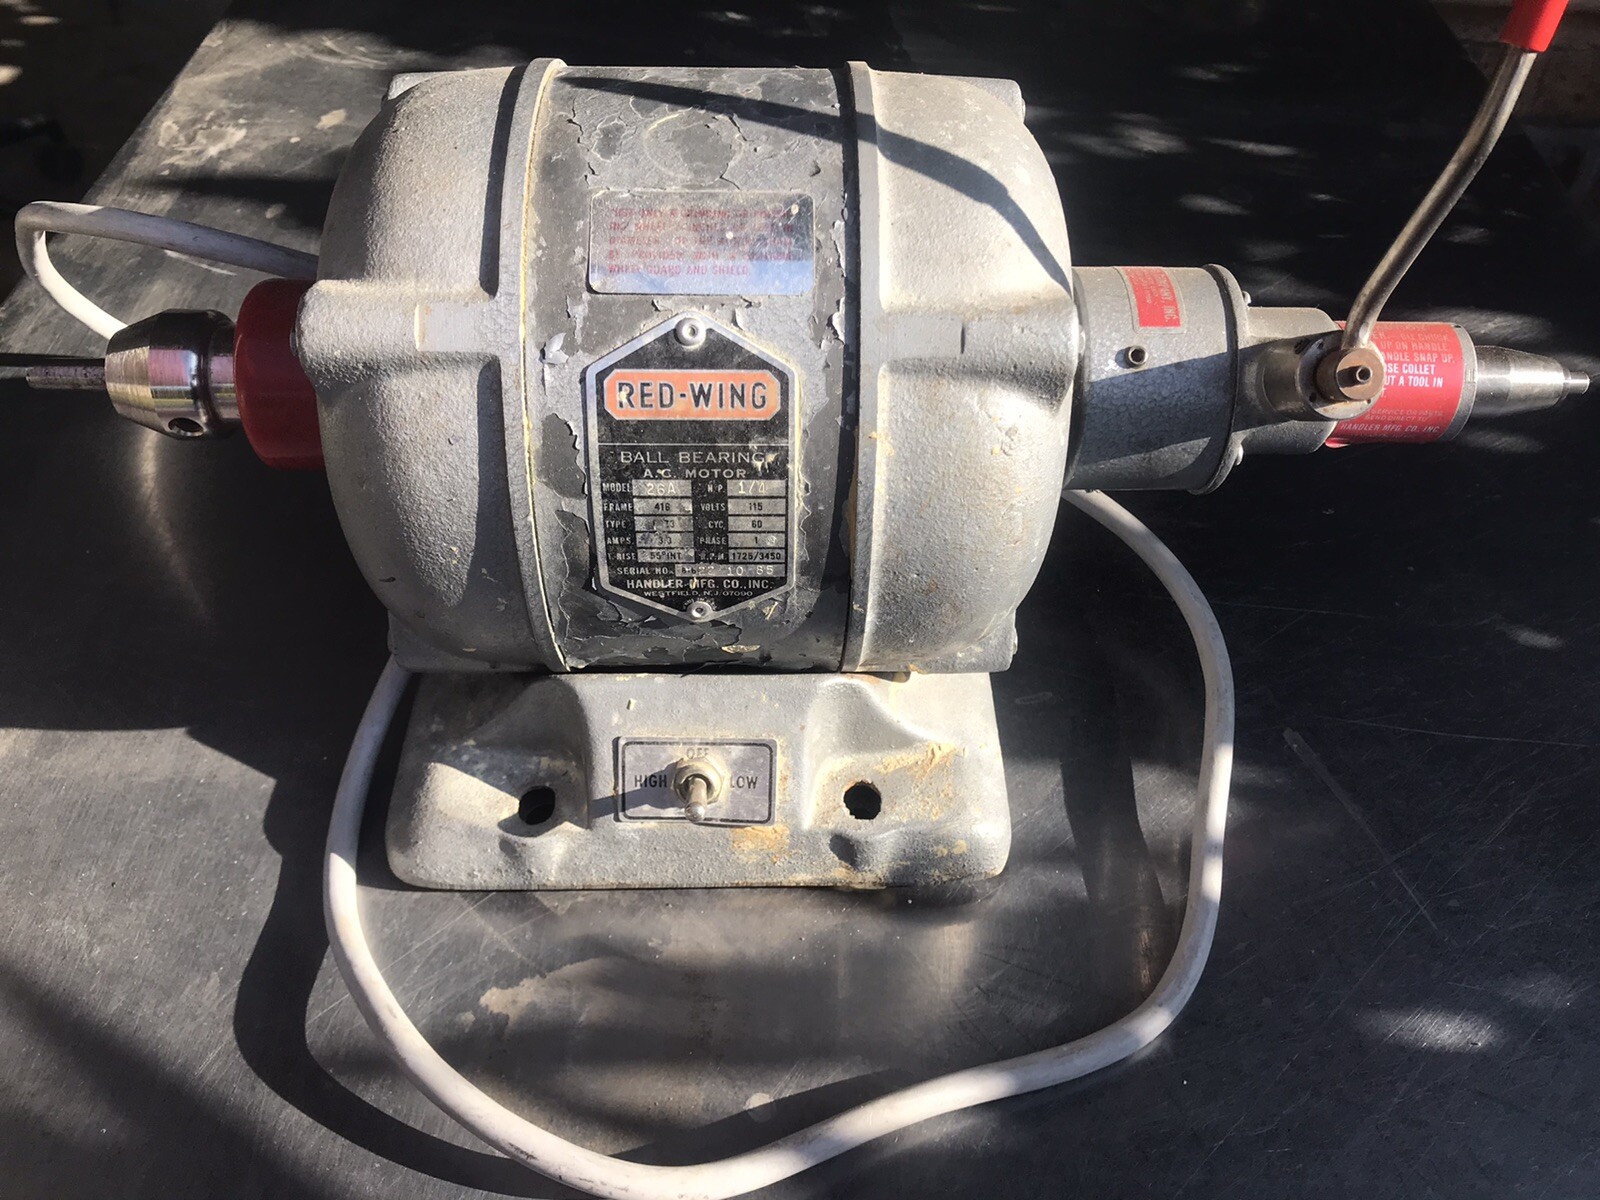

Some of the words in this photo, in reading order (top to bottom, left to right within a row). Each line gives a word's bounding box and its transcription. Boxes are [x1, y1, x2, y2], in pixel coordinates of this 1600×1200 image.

[647, 265, 681, 274] GUARD
[687, 265, 708, 274] AND
[713, 265, 749, 275] SHIELD
[1381, 341, 1392, 350] UP
[1395, 342, 1408, 350] ON
[1413, 352, 1438, 362] SNAP
[1440, 353, 1455, 364] UP.
[1402, 363, 1435, 375] COLLET
[1384, 375, 1396, 386] UT
[1398, 375, 1405, 386] A
[1408, 376, 1430, 387] TOOL
[1432, 376, 1444, 388] IN
[617, 381, 768, 410] RED-WING
[1340, 423, 1380, 431] HANDLER
[620, 451, 669, 464] BALL
[678, 451, 765, 464] BEARING
[685, 468, 747, 479] MOTOR
[602, 482, 632, 492] MODEL
[646, 482, 676, 496] 26A
[738, 480, 765, 494] 1/4
[603, 502, 633, 512] FRAME
[654, 502, 671, 511] 416
[700, 502, 726, 511] VOLTS
[749, 502, 763, 511] 115
[605, 520, 627, 528] TYPE
[751, 519, 763, 529] 60
[699, 536, 727, 545] PHASE
[754, 536, 759, 544] 1
[616, 552, 637, 560] RISE
[732, 552, 782, 561] 1725/3450
[616, 566, 651, 575] SERIAL
[727, 565, 744, 576] 10
[626, 579, 684, 589] HANDLER
[689, 579, 719, 589] MFG.
[634, 774, 668, 788] HIGH
